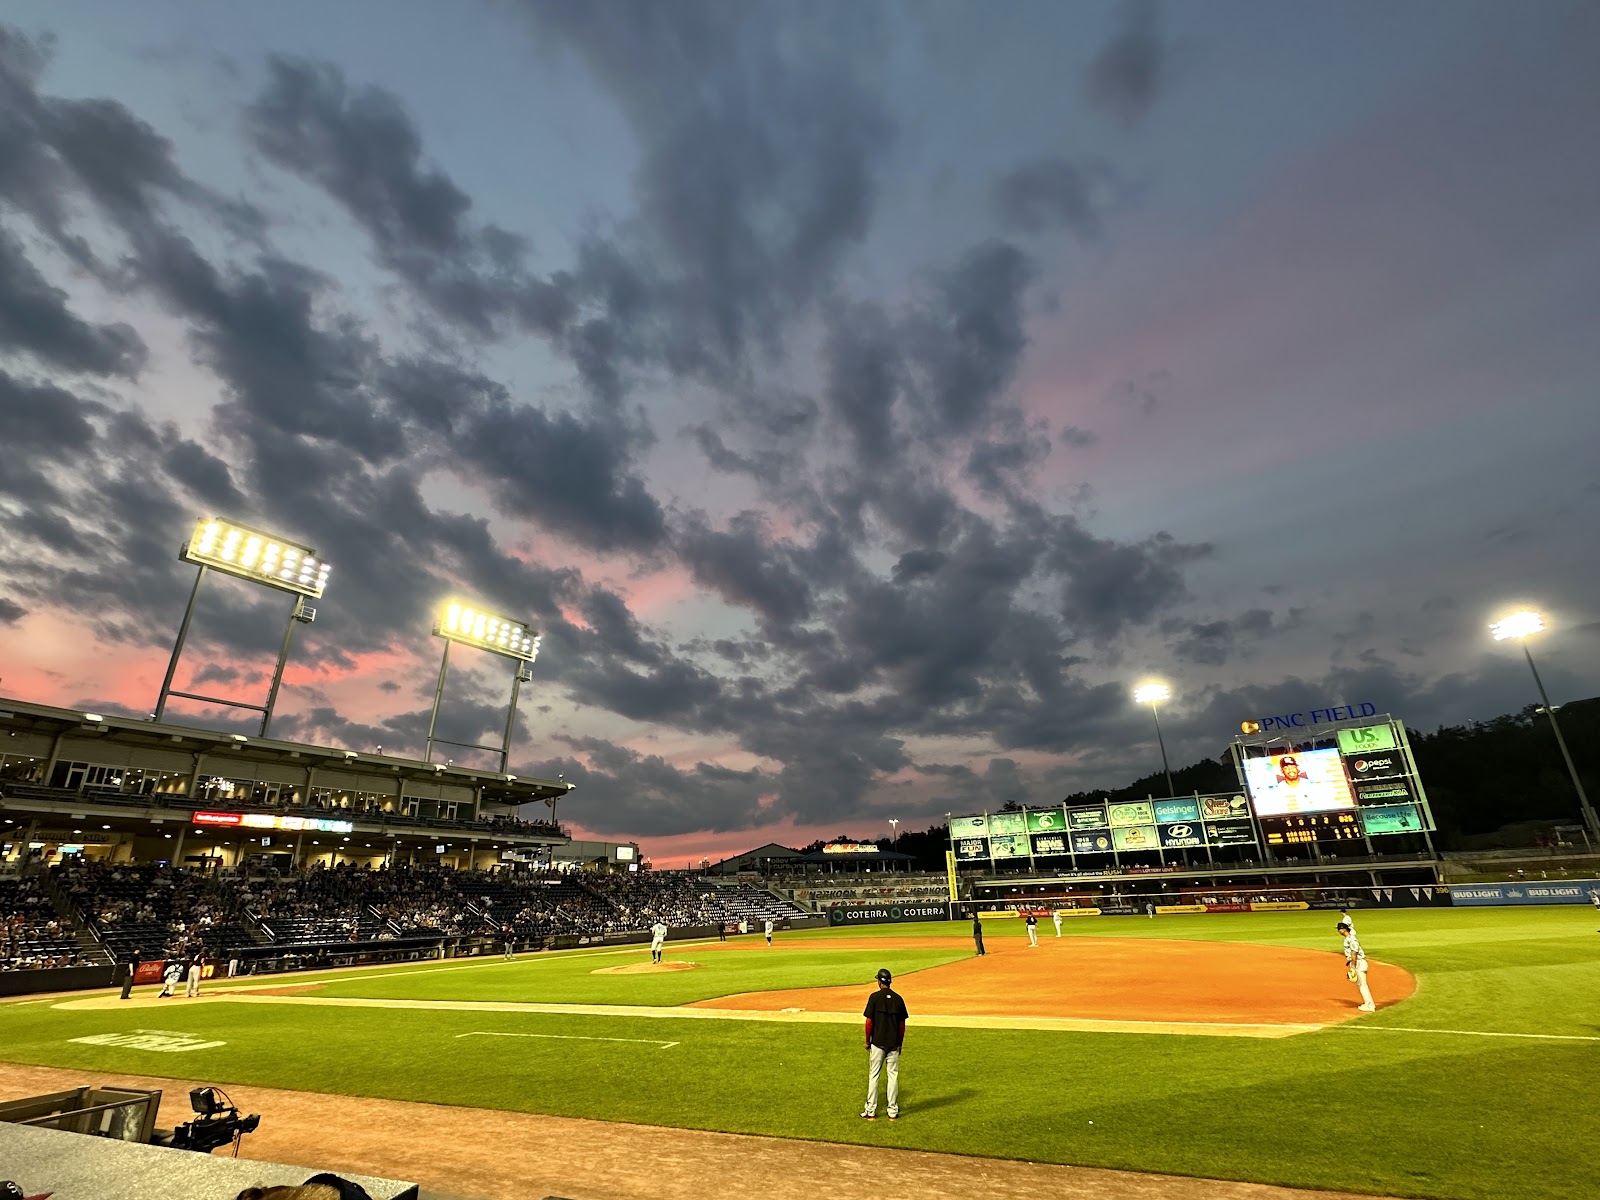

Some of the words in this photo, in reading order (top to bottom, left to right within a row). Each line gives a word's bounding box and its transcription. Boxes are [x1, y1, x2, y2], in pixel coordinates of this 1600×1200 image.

[1260, 713, 1304, 731] PNC
[1309, 702, 1376, 724] FIELD
[1355, 742, 1379, 750] FOODS
[1368, 758, 1392, 768] pepsi
[1156, 805, 1196, 816] Geisinger
[1366, 813, 1396, 821] Because
[1036, 839, 1064, 848] NEWS
[1165, 837, 1200, 846] HYUNDAI
[1473, 890, 1500, 898] LIGHT
[846, 910, 888, 919] COTERRA
[903, 907, 945, 917] COTERRA
